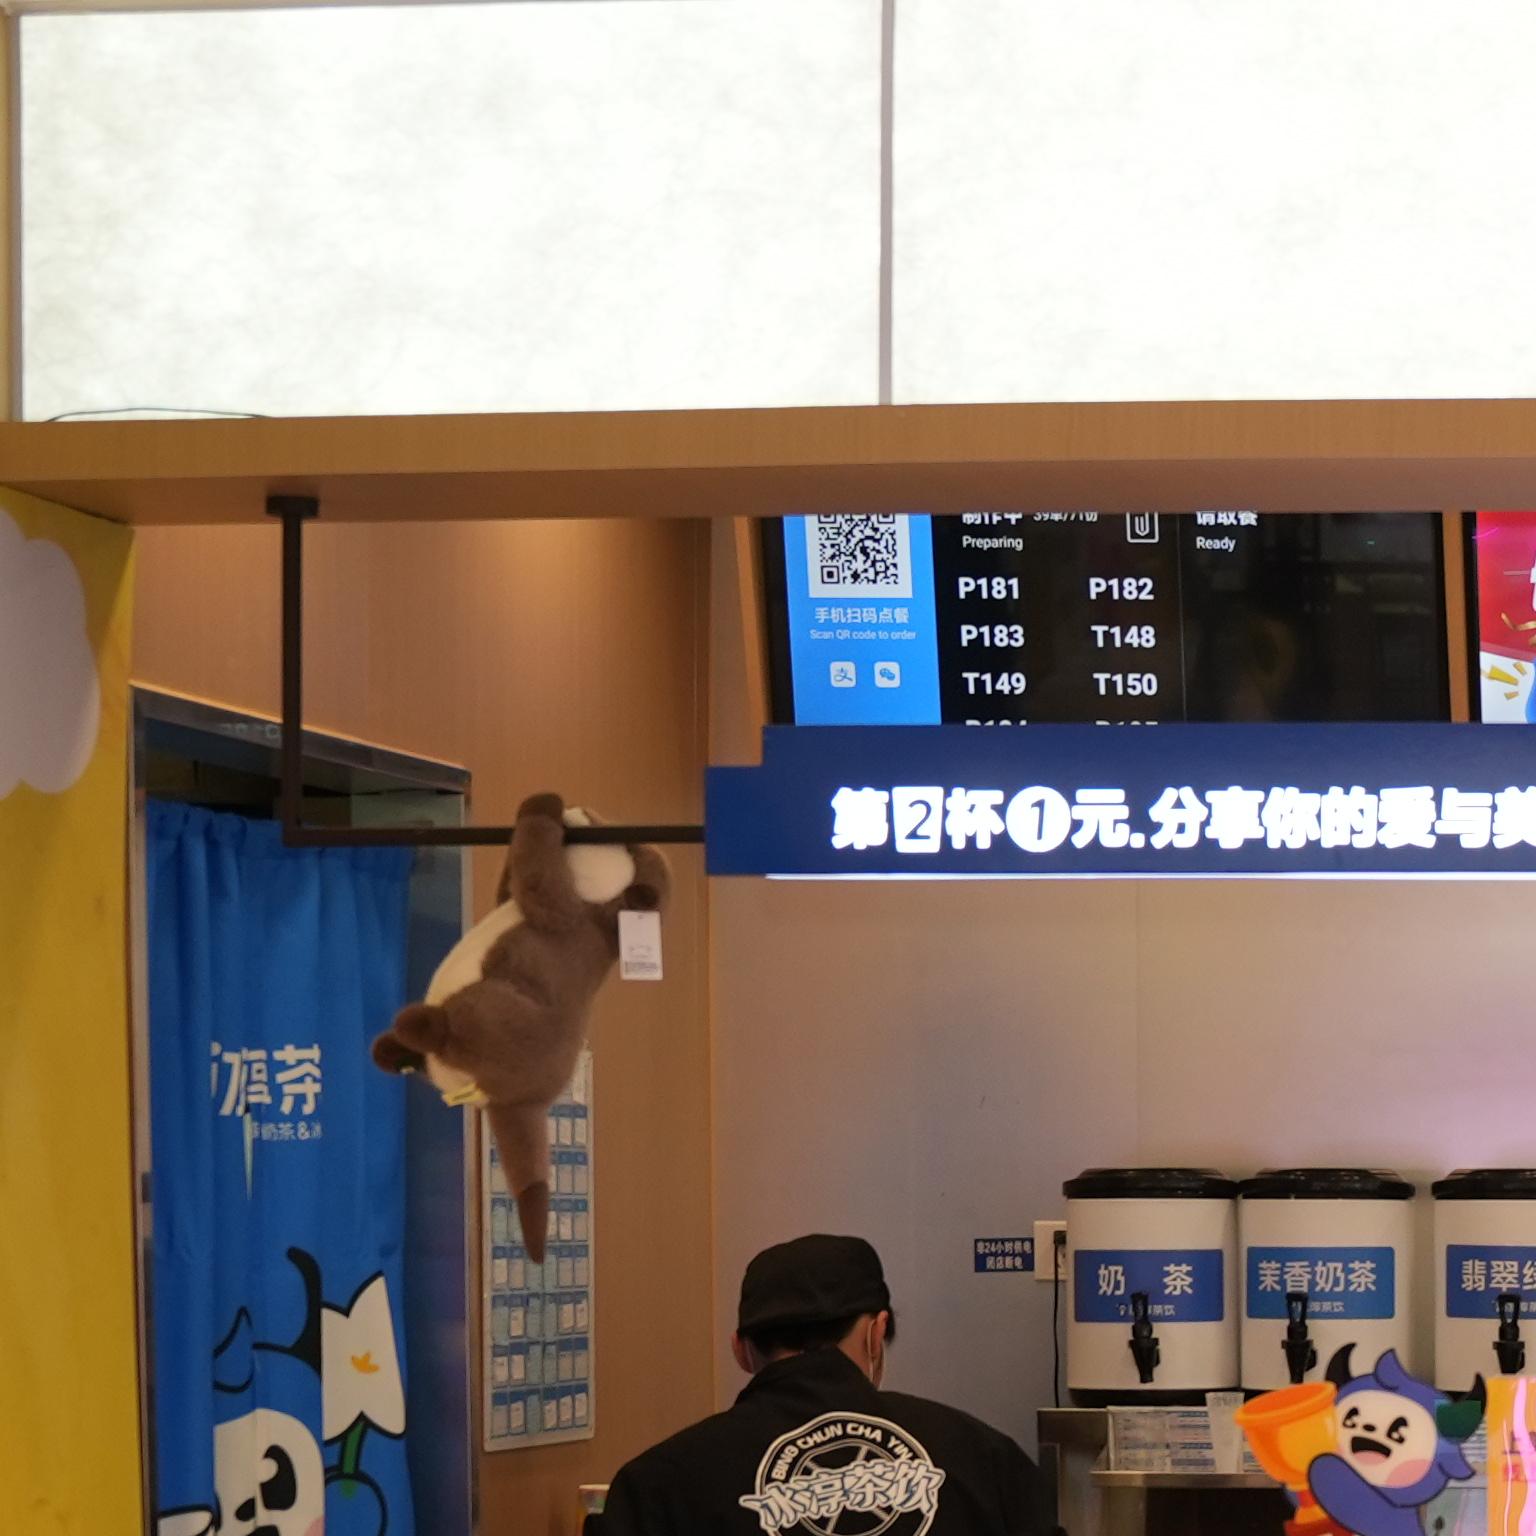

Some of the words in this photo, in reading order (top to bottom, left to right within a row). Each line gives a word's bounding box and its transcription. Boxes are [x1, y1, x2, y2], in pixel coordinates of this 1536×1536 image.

[962, 536, 1024, 551] Preparing
[1196, 536, 1236, 552] Ready
[958, 576, 1020, 600] P181
[1089, 577, 1155, 600] P182
[814, 607, 910, 624] 手机扫码点餐
[810, 629, 835, 640] Scan
[836, 629, 851, 640] QR
[853, 629, 877, 640] code
[878, 630, 889, 640] to
[890, 629, 916, 640] order
[960, 624, 1026, 648] P183
[1091, 625, 1157, 648] T148
[962, 672, 1027, 695] T149
[1093, 673, 1158, 696] T150
[1257, 1259, 1377, 1294] 茉香奶茶
[771, 1445, 800, 1481] BING
[796, 1423, 844, 1450] CHUN
[846, 1422, 883, 1443] CHA
[886, 1435, 914, 1462] YIN
[739, 1459, 947, 1531] 冰淳茶饮
